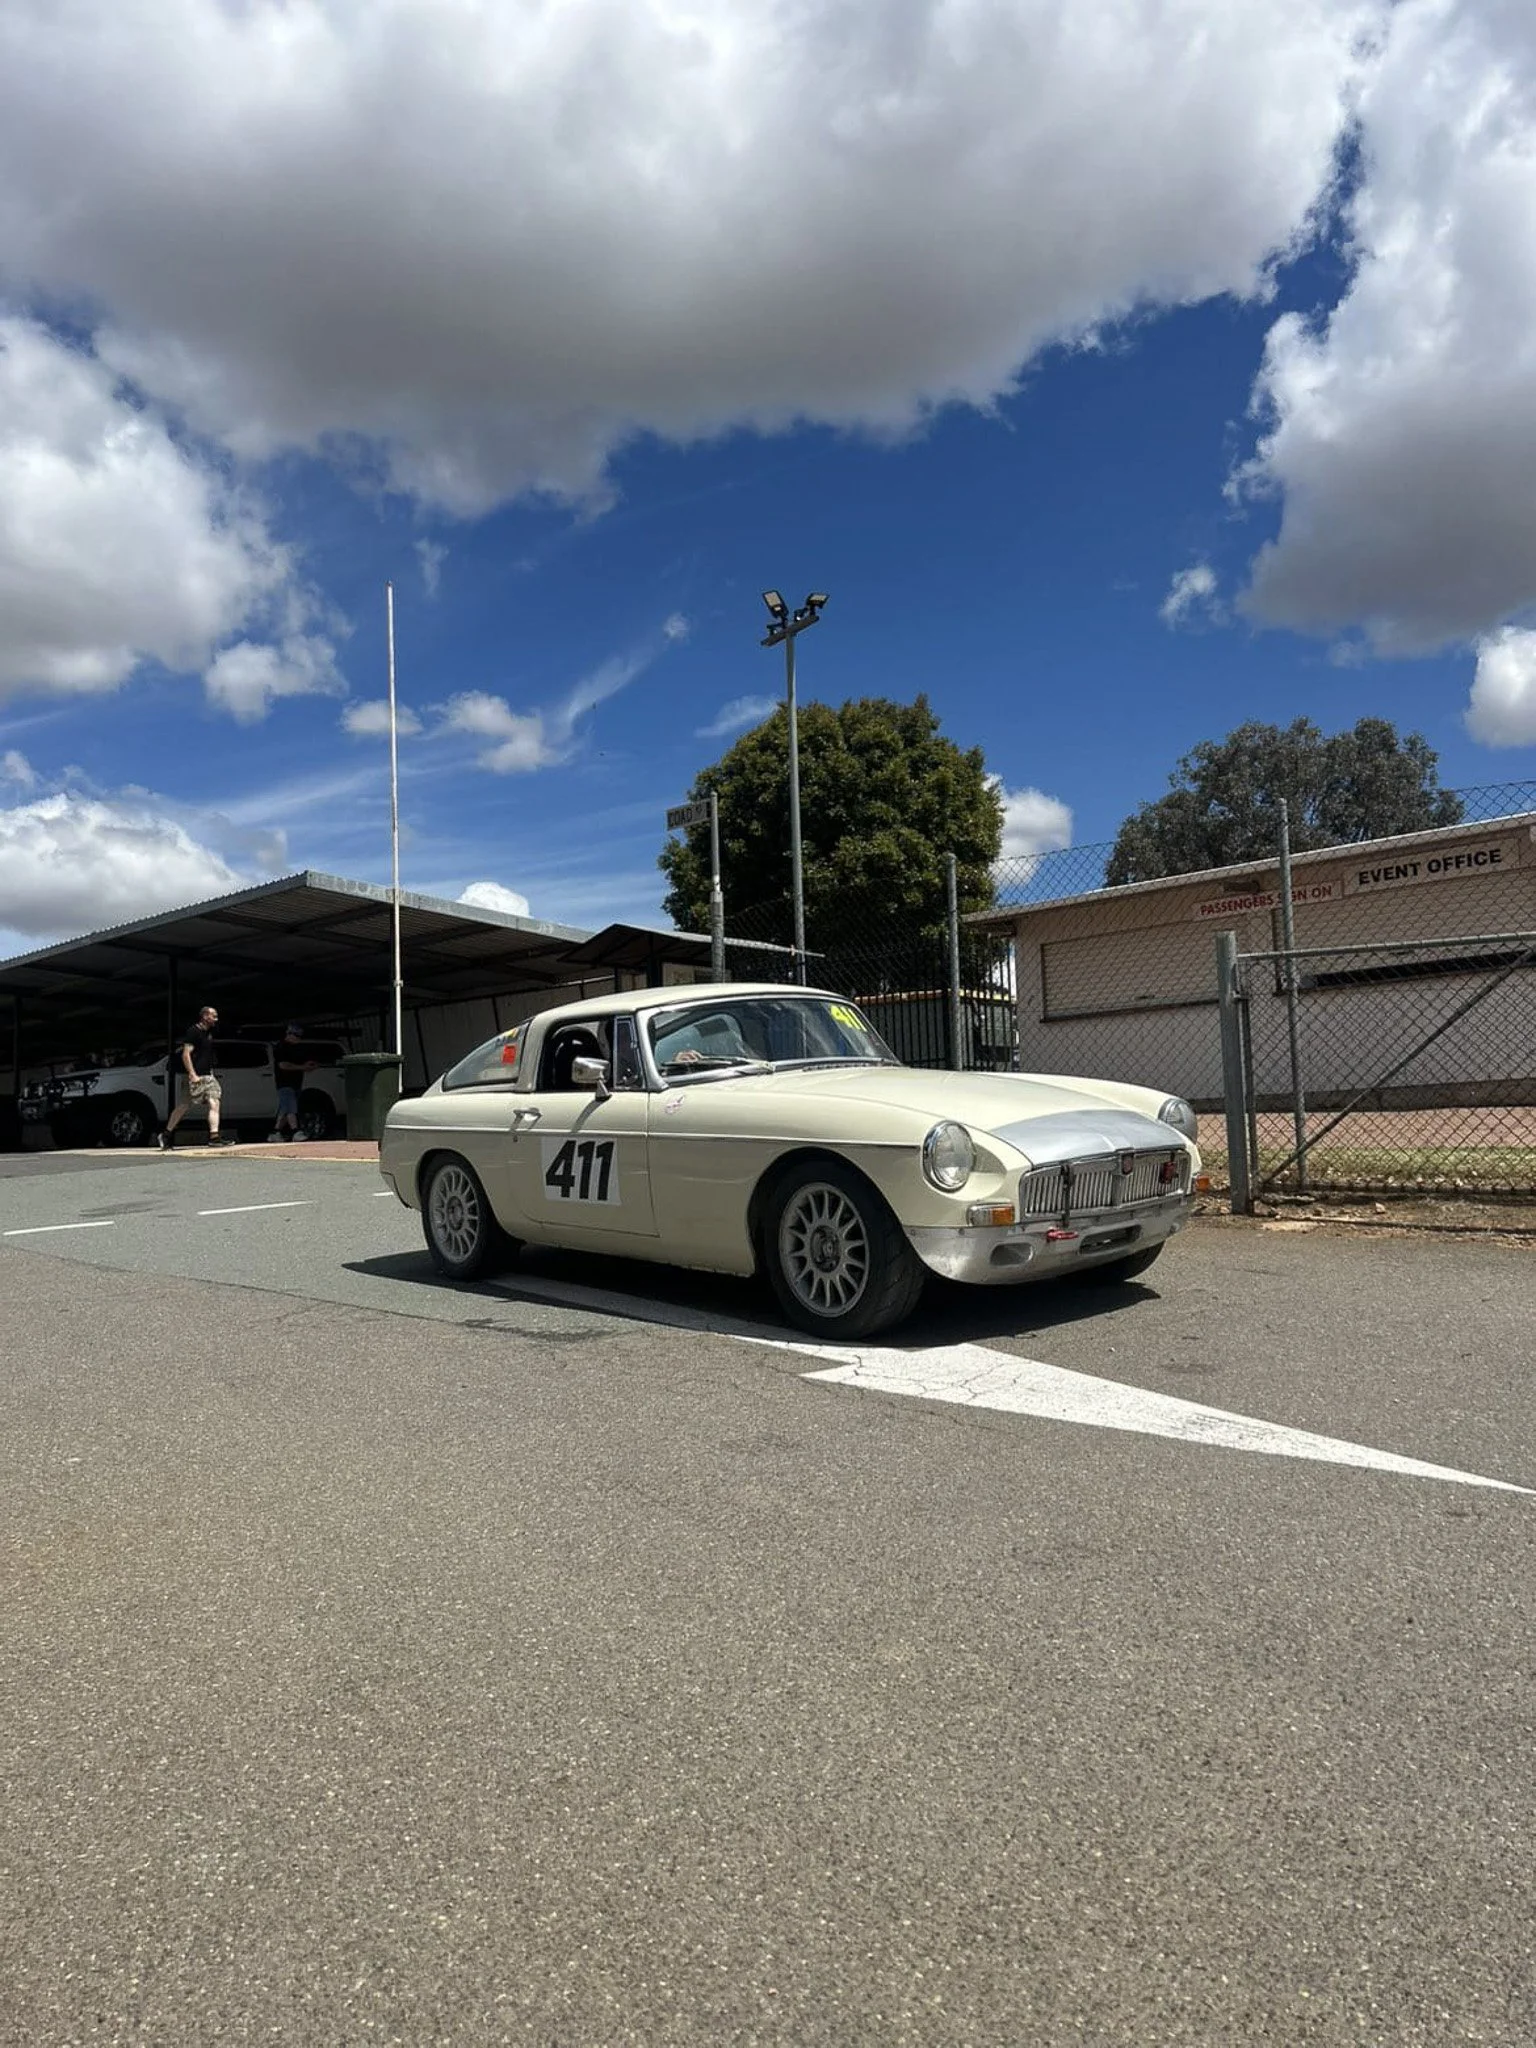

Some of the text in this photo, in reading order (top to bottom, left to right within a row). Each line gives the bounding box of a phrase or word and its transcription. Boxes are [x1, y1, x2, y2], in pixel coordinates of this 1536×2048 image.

[1359, 848, 1502, 885] EVENT OFFICE
[1200, 885, 1332, 916] PASSENGERS SGN ON
[831, 1005, 867, 1032] 411
[545, 1140, 614, 1201] 411
